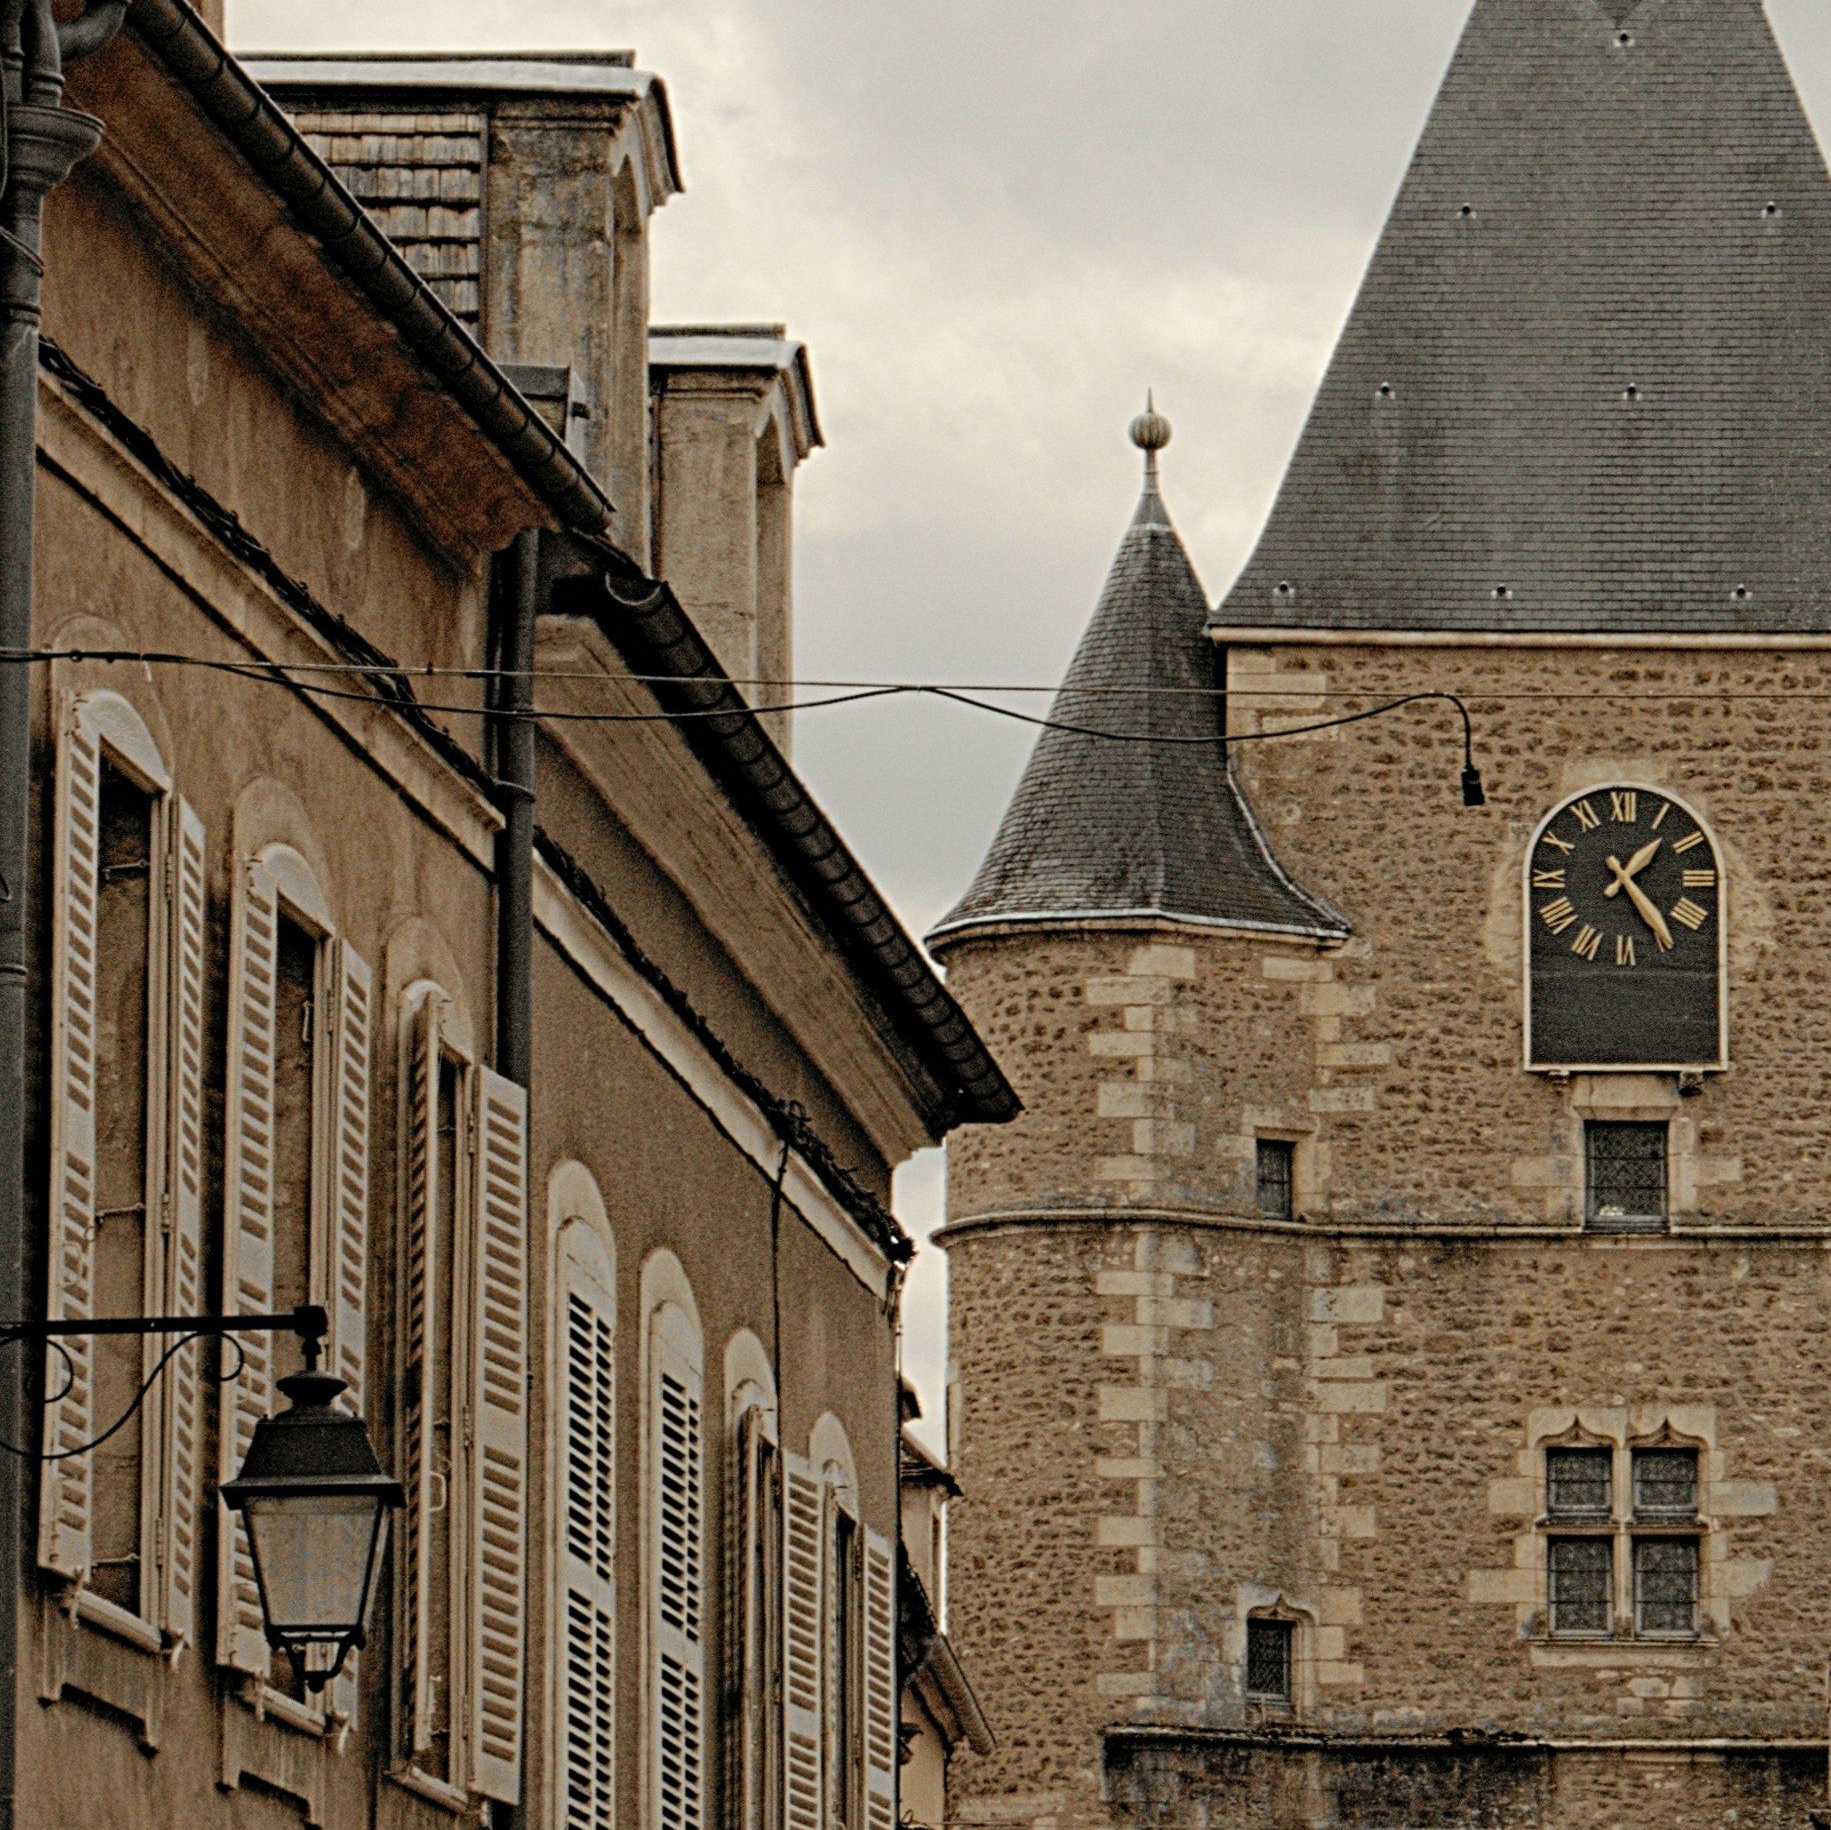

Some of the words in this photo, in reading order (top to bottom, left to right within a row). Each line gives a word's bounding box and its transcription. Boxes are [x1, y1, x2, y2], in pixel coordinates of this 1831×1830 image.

[1570, 800, 1601, 833] XI
[1610, 791, 1636, 822] XII
[1543, 830, 1575, 855] X
[1533, 869, 1566, 888] IX
[1682, 869, 1715, 887] III
